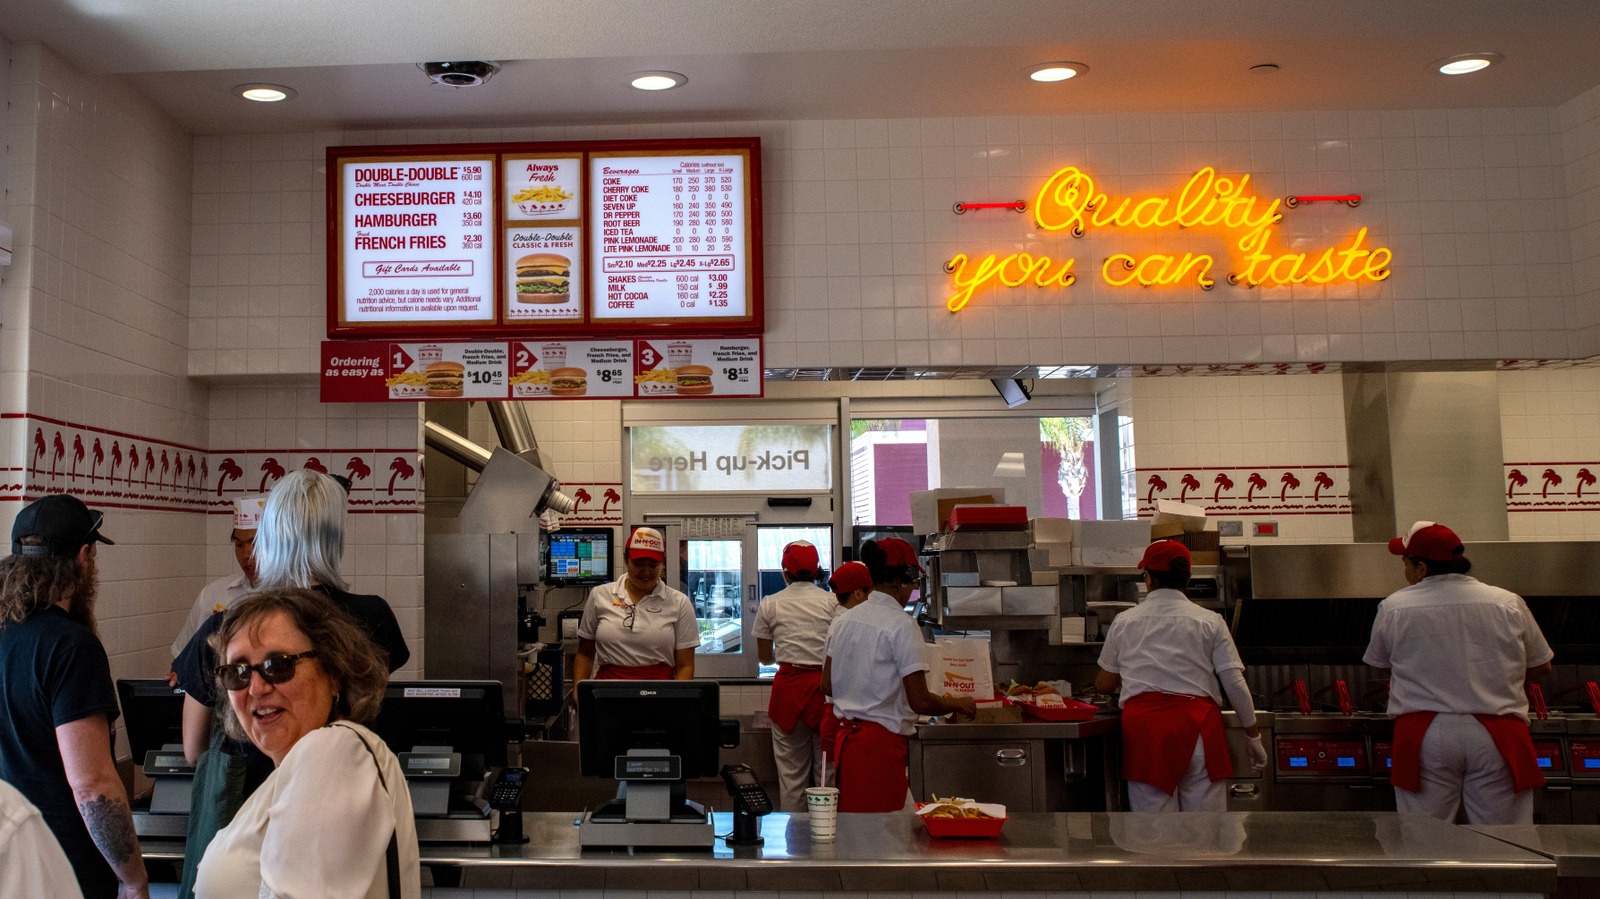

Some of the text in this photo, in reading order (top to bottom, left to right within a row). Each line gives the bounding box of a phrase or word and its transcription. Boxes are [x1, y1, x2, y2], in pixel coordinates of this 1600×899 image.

[526, 164, 559, 173] Always
[603, 167, 640, 175] Beverages
[355, 167, 458, 182] DOUBLE-DOUBLE
[528, 172, 556, 182] Fresh
[603, 186, 629, 194] CHERRY
[355, 191, 455, 206] CHEESEBURGER
[620, 194, 638, 202] COKE
[1035, 167, 1283, 252] Quality
[355, 212, 482, 228] HAMBURGER $3.60
[615, 211, 640, 219] PEPPER
[604, 228, 619, 236] ICED
[355, 234, 482, 250] FRENCH FRIES $2.30
[513, 233, 573, 242] Double-Double
[621, 236, 658, 244] LEMONADE
[376, 264, 460, 274] Gift Cards Available
[946, 227, 1392, 312] you can taste
[608, 275, 636, 283] SHAKES
[690, 274, 699, 282] cal
[708, 274, 728, 282] $3.00
[411, 288, 420, 296] day
[608, 284, 626, 292] MILK
[608, 292, 622, 300] HOT
[624, 292, 648, 300] COCOA
[709, 291, 728, 299] $2.25
[608, 299, 728, 309] COFFEE cal $1.35
[330, 356, 380, 368] Ordering
[393, 352, 405, 368] 1
[516, 350, 529, 367] 2
[641, 349, 655, 365] 3
[325, 368, 384, 378] as easy as
[943, 681, 975, 689] IN-N-OUT
